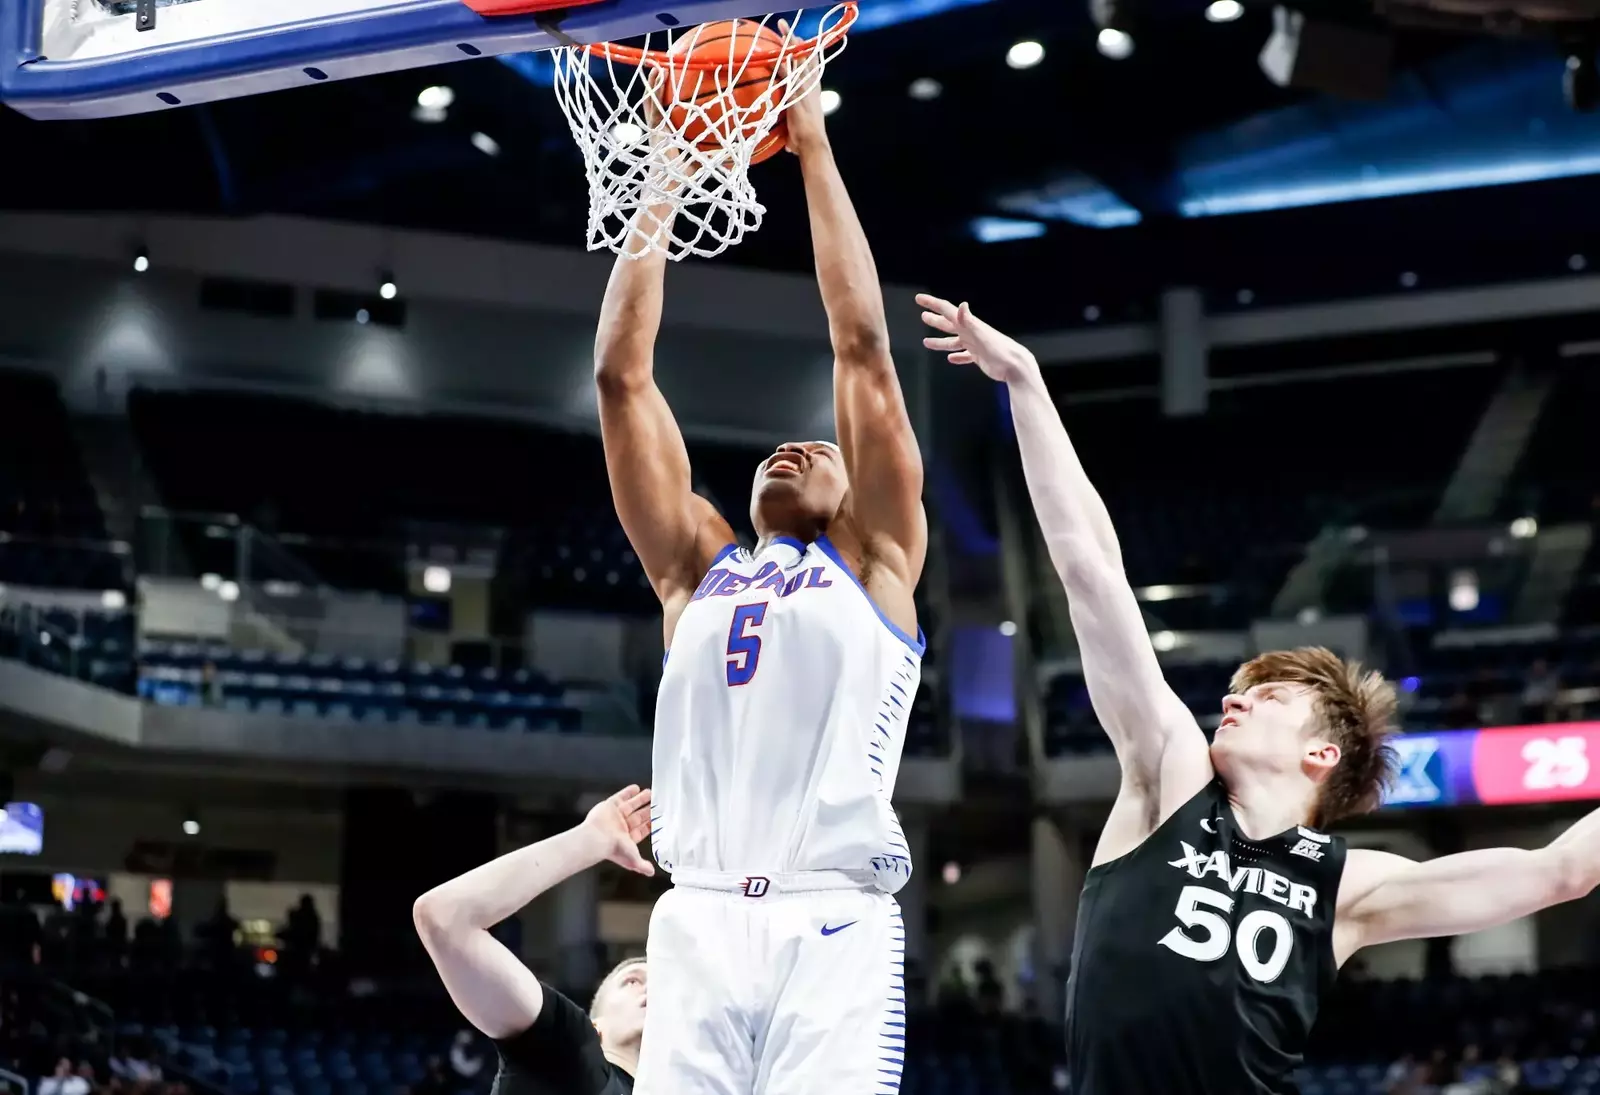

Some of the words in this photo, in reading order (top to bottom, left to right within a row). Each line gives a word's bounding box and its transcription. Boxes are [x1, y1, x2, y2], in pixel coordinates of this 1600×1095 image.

[688, 561, 833, 603] DEPAUL
[726, 601, 769, 687] 5
[1521, 736, 1590, 790] 25
[1167, 840, 1318, 919] XAVIER
[1157, 885, 1294, 983] 50
